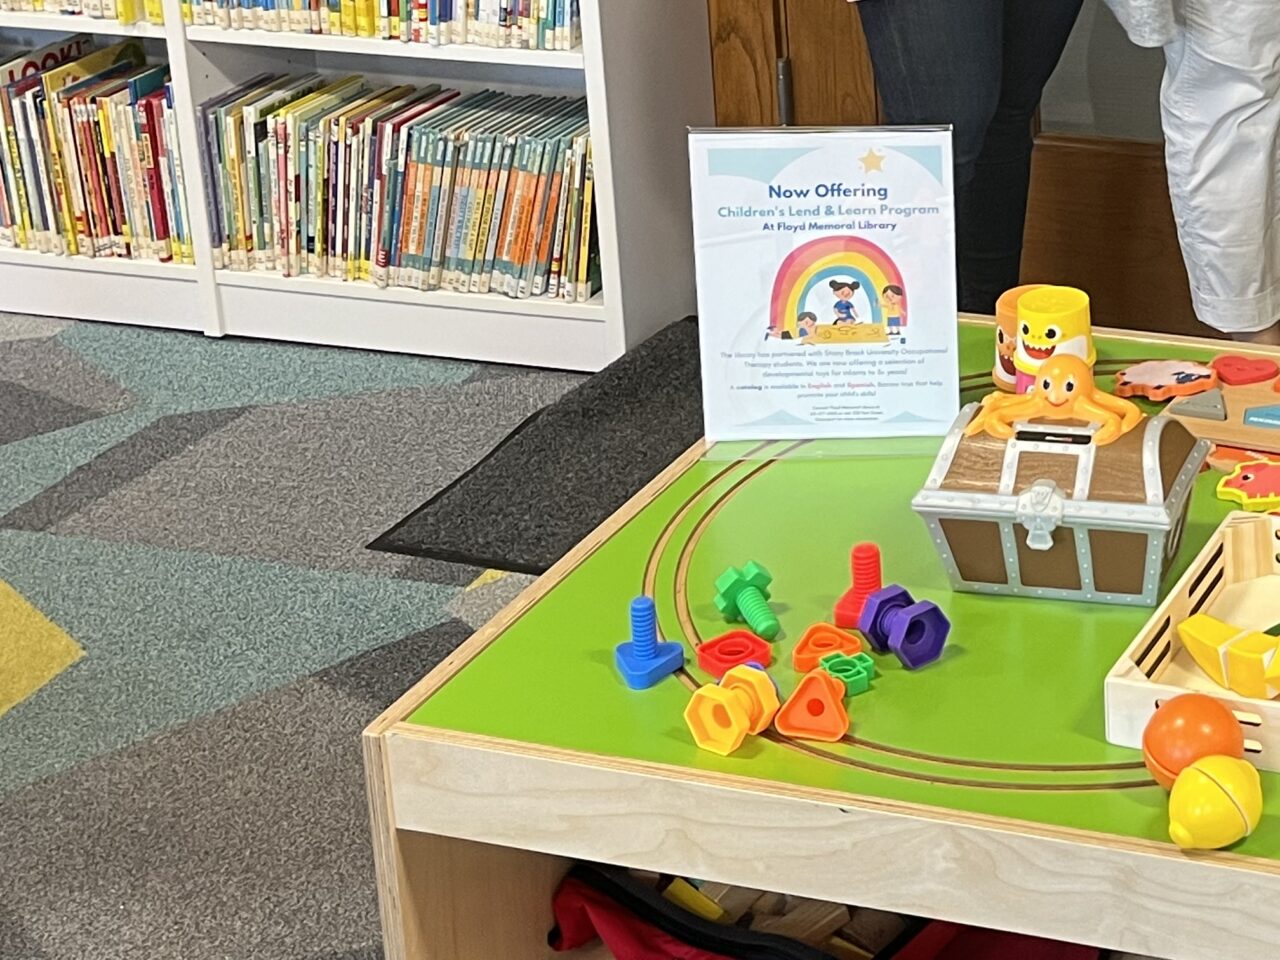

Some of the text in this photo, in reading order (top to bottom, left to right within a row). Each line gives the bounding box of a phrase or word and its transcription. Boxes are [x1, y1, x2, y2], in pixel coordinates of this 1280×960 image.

[768, 182, 889, 201] Now Offering
[717, 203, 940, 218] Children's Lend & Learn Program
[762, 222, 774, 231] At
[777, 221, 806, 234] Floyd
[857, 220, 897, 232] Library
